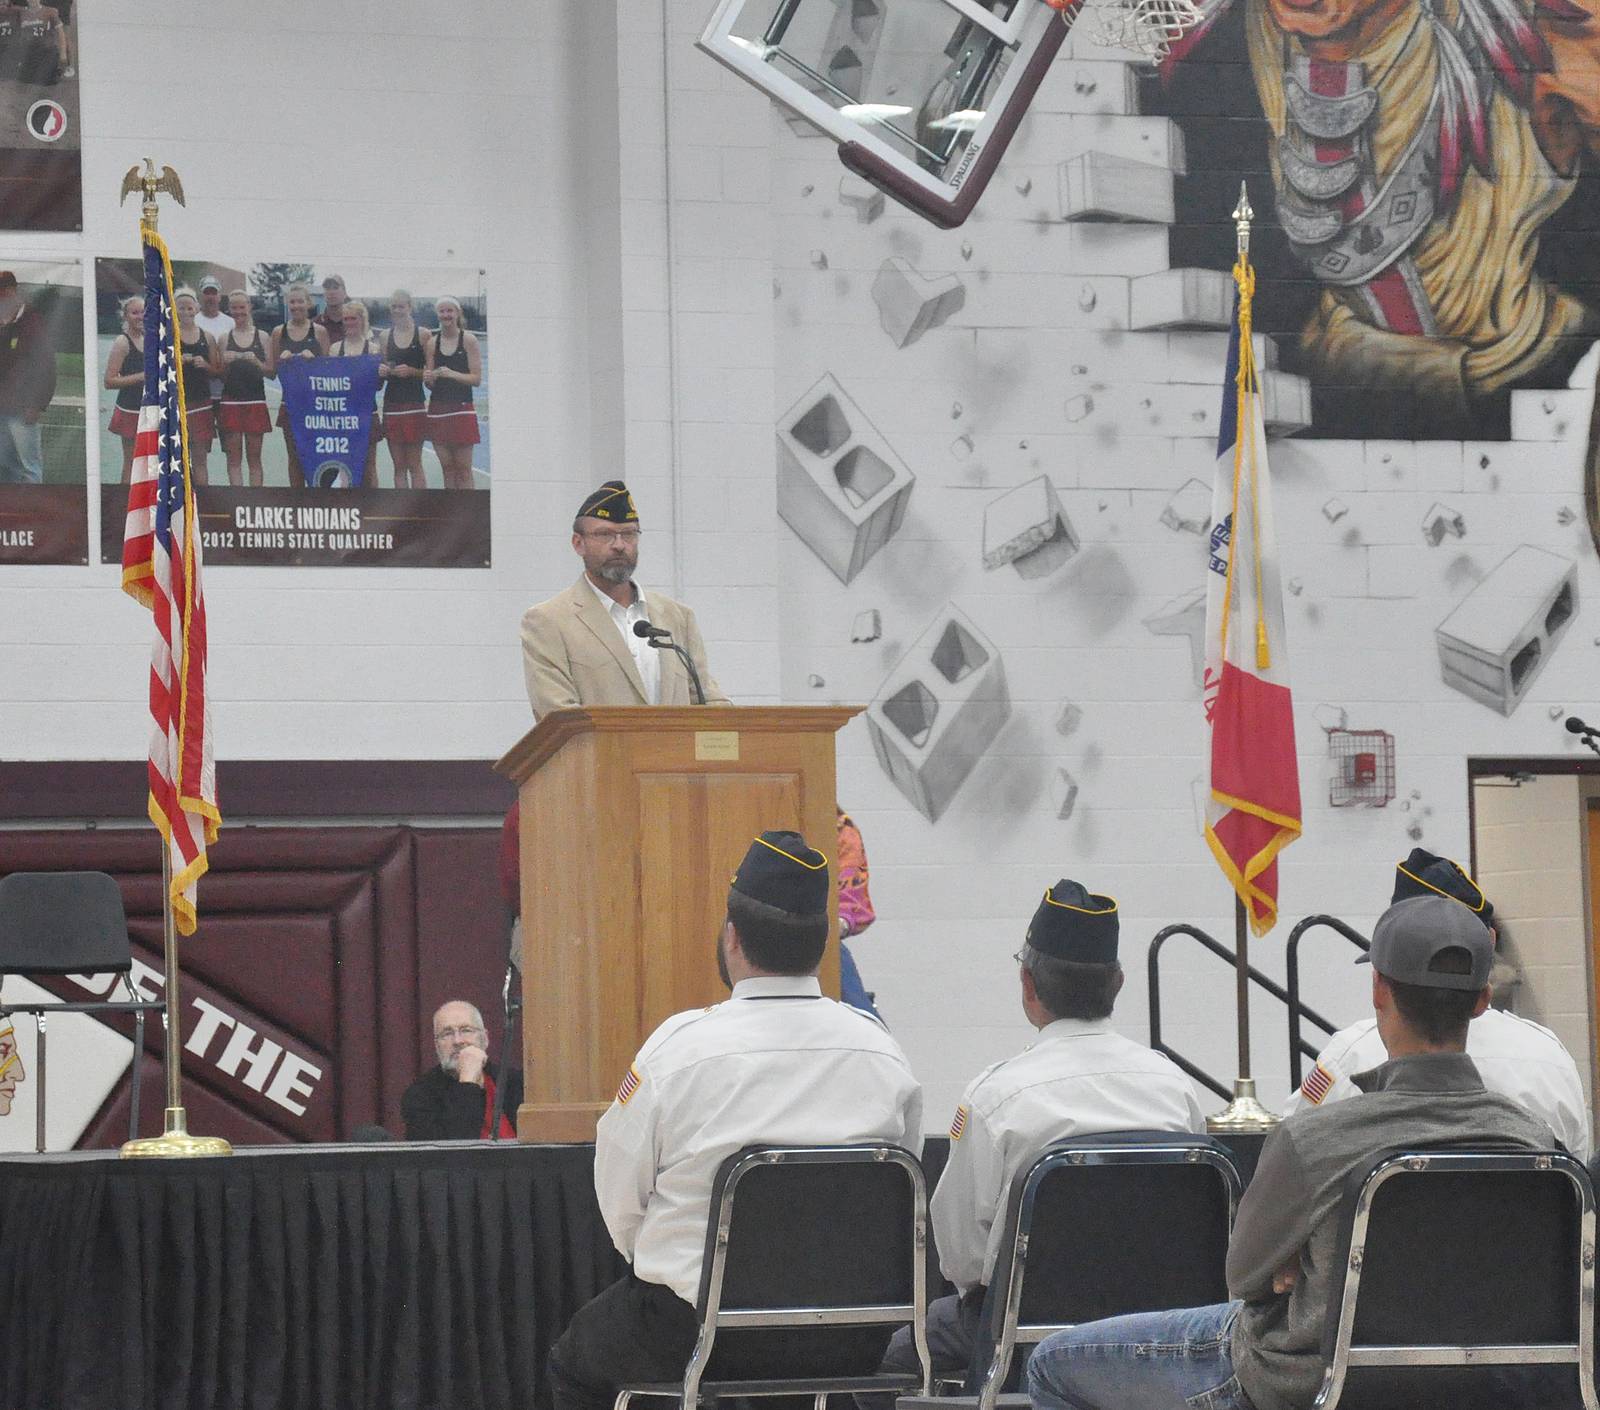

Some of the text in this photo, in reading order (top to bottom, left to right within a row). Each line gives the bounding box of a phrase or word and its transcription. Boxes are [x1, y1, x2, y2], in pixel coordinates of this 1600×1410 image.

[949, 142, 980, 191] SPALDING
[309, 376, 351, 391] TENNIS
[315, 396, 347, 412] STATE
[305, 415, 360, 430] QUALIFIER
[315, 437, 349, 453] 2012
[235, 506, 361, 530] CLARKE INDIANS
[0, 530, 34, 546] LACE
[202, 532, 394, 550] 2012 TENNIS STATE QUALIFIER
[184, 996, 323, 1118] THE
